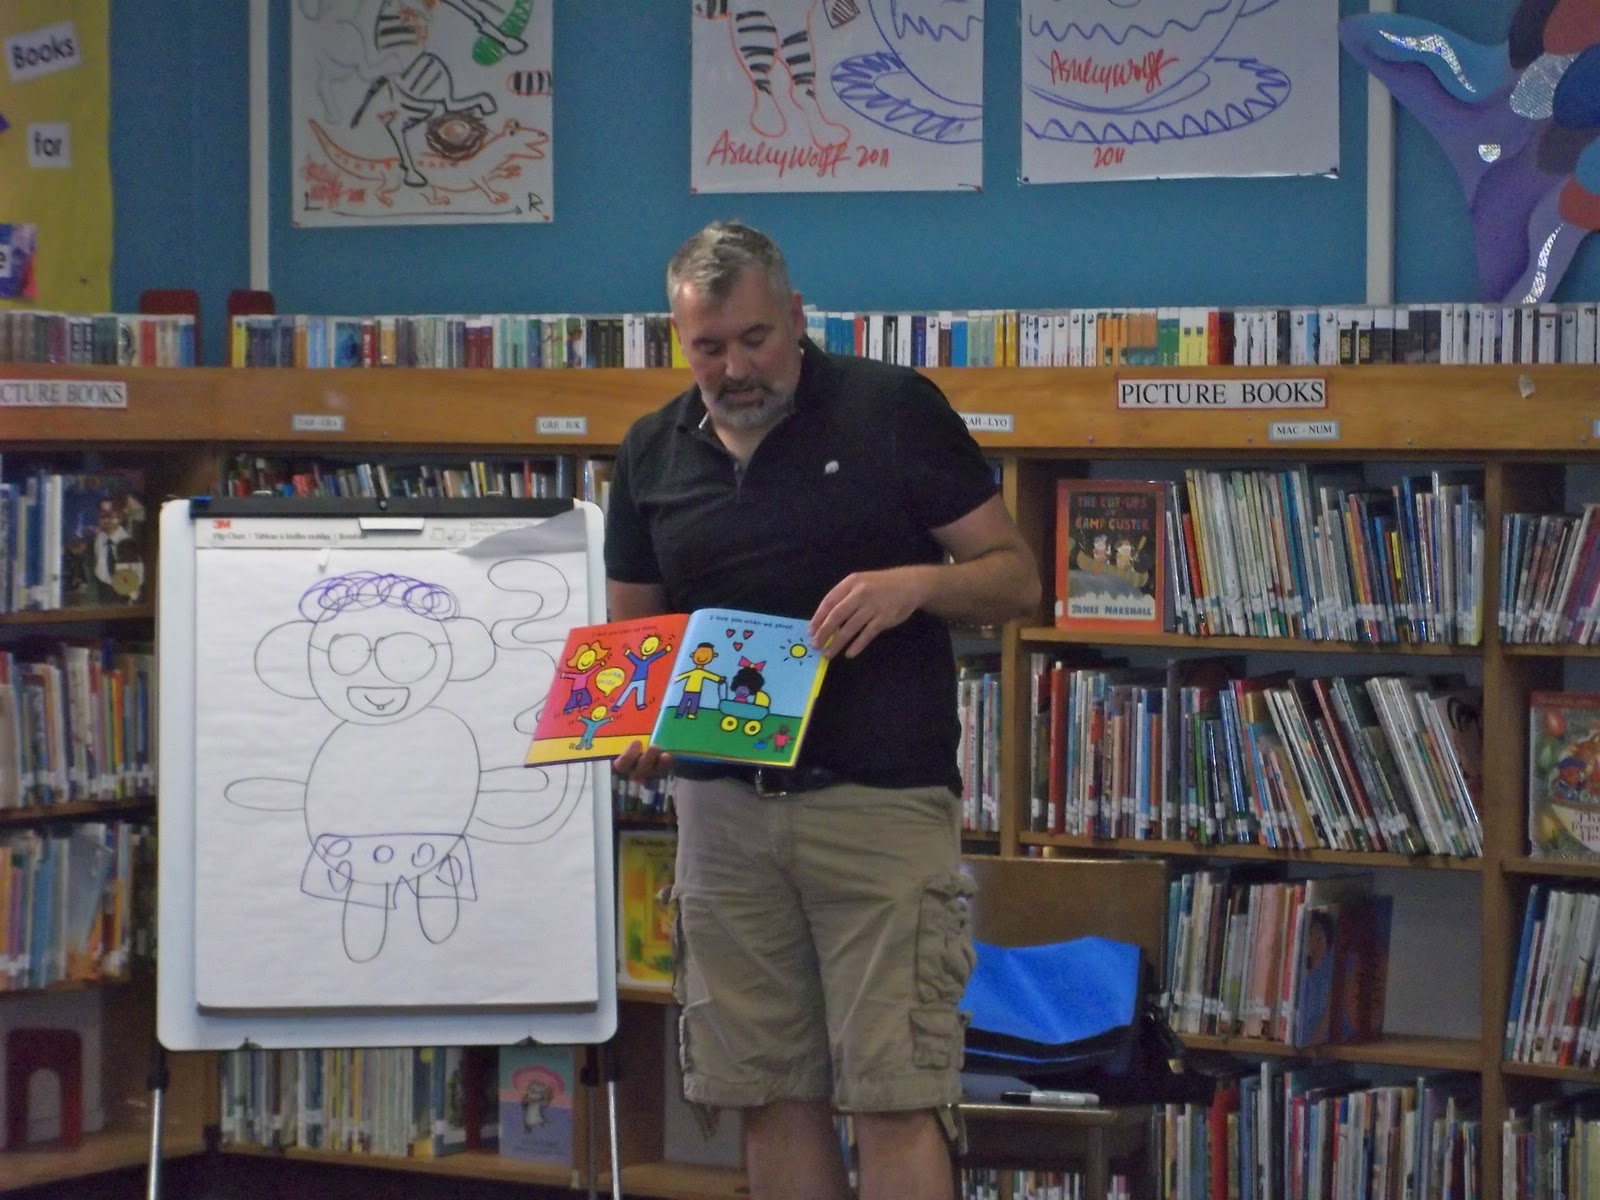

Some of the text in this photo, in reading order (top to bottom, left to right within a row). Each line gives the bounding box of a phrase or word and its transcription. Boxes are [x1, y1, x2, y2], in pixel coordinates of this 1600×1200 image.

[13, 34, 75, 70] Books
[34, 129, 63, 157] for
[856, 145, 890, 168] 2011
[1093, 146, 1126, 168] 2011
[67, 383, 125, 404] BOOKS
[1121, 381, 1324, 405] PICTURE BOOKS
[1276, 425, 1301, 435] MAC
[1308, 424, 1333, 435] NUM
[212, 519, 232, 529] 3M
